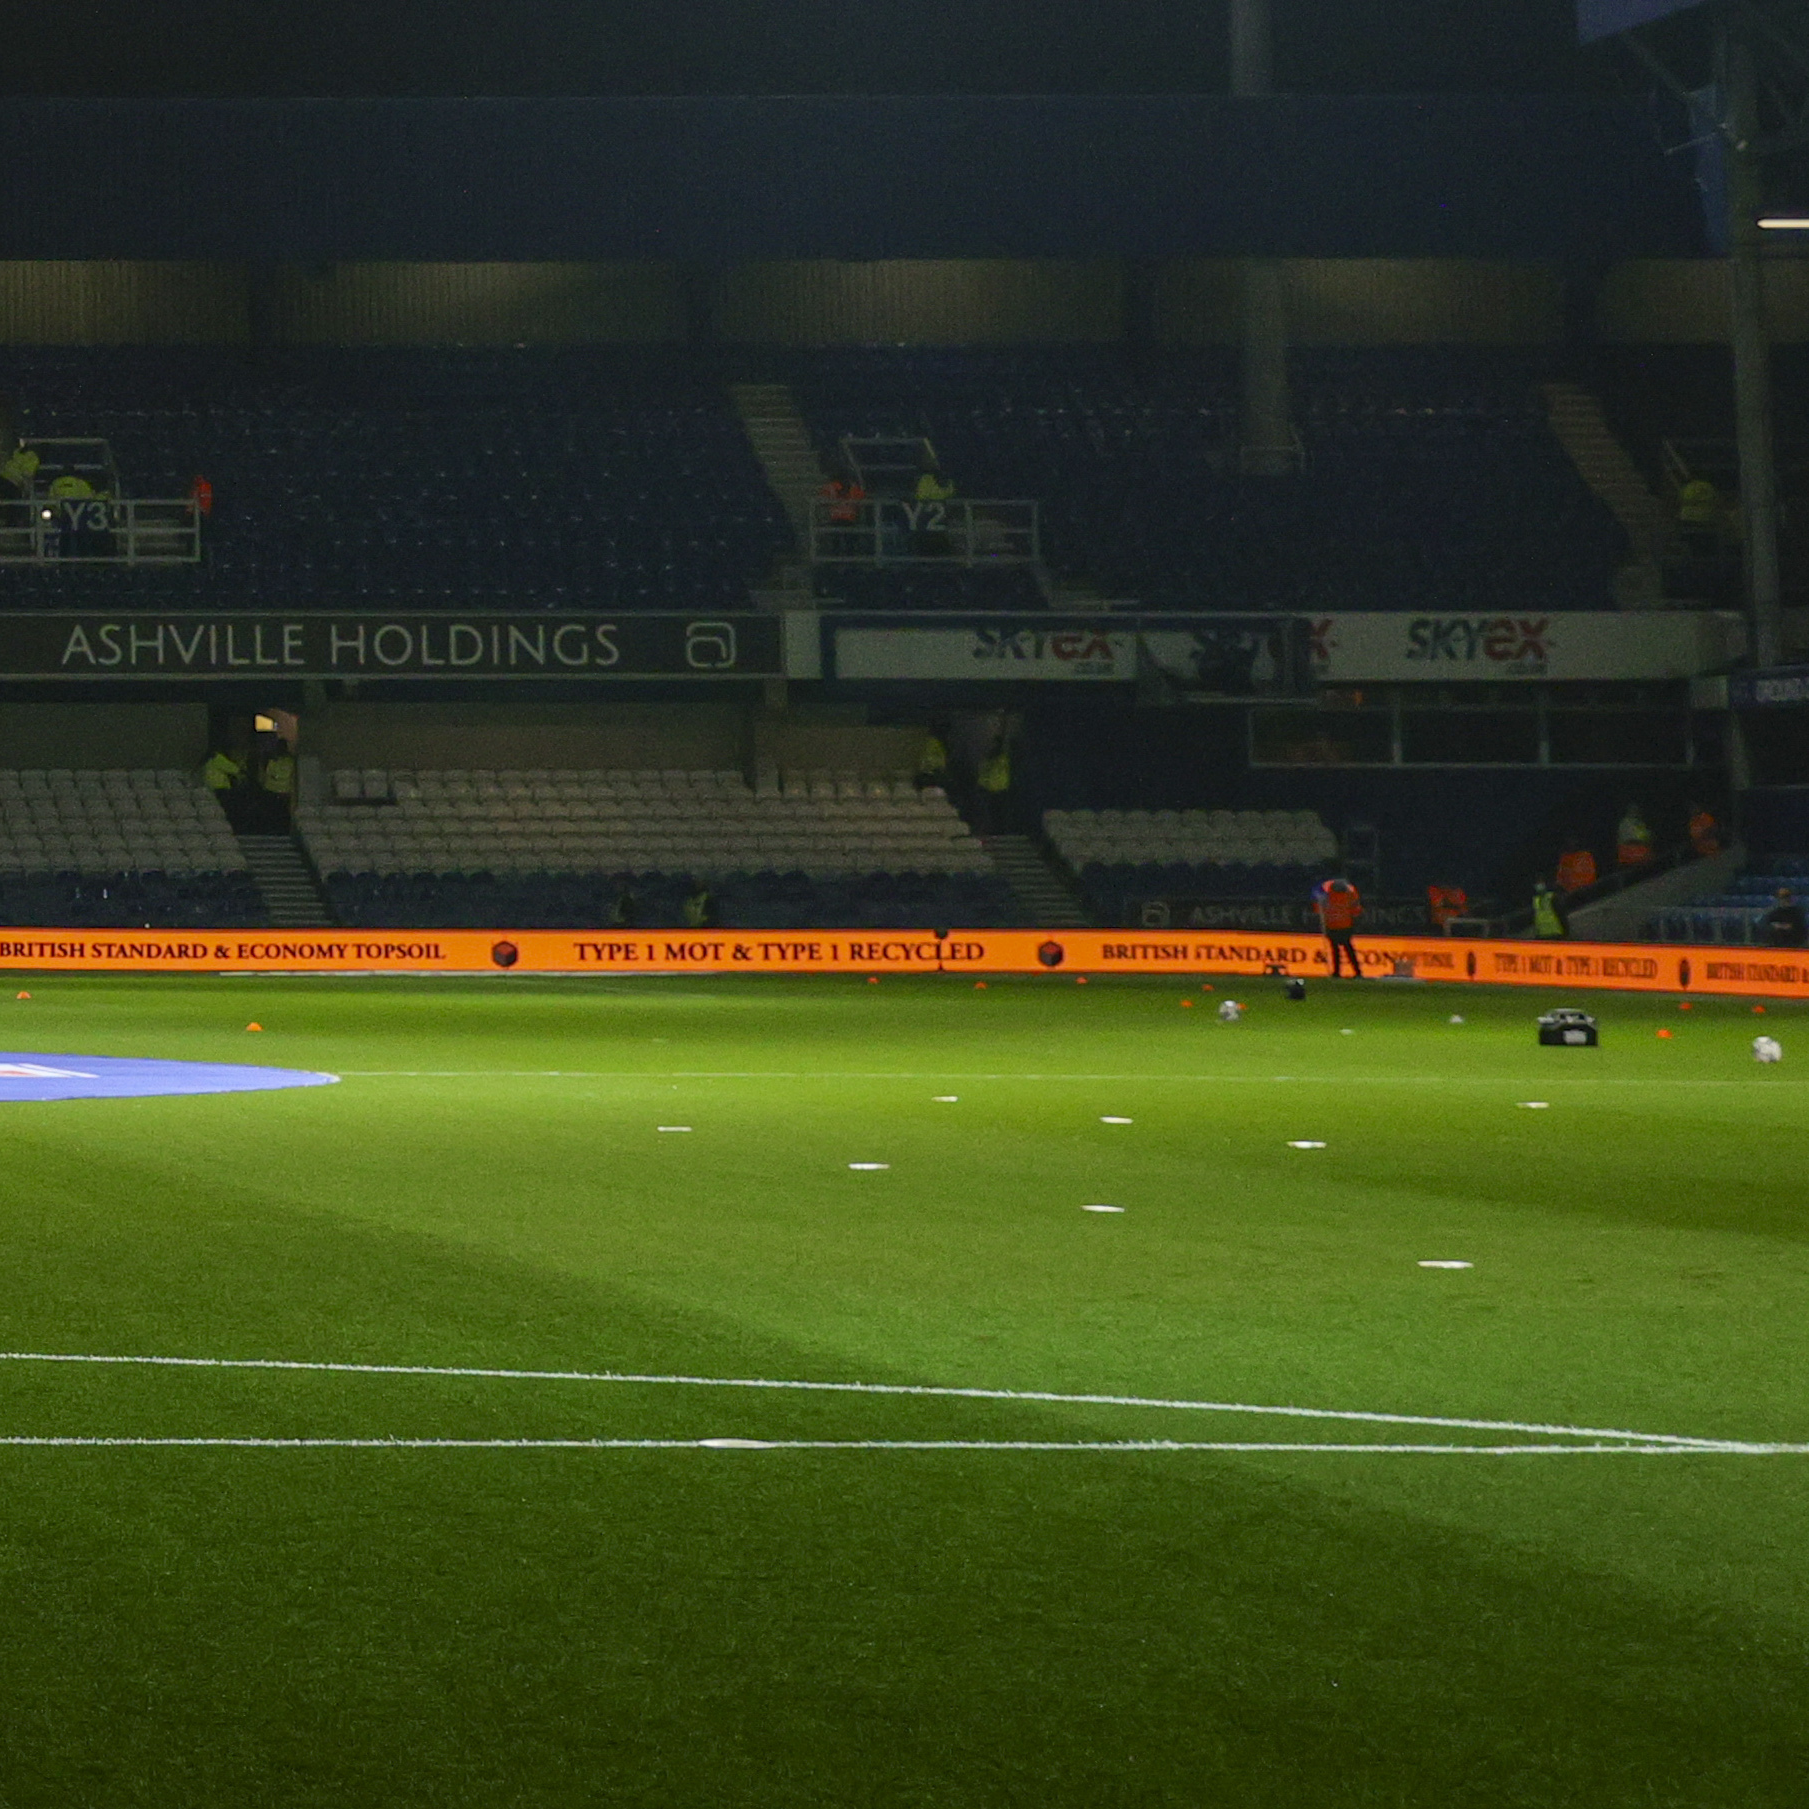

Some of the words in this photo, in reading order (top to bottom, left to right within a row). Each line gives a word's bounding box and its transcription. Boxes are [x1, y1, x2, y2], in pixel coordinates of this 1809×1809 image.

[63, 501, 108, 531] Y3
[902, 500, 946, 531] Y2
[62, 624, 305, 665] ASHVILLE
[331, 624, 620, 666] HOLDINGS
[0, 942, 85, 959] BRITISH
[91, 942, 208, 959] STANDARD
[214, 943, 229, 959] &
[237, 943, 348, 959] ECONOMY
[352, 943, 446, 959] TOPSOIL
[574, 943, 639, 961] TYPE
[647, 943, 655, 960] 1
[665, 943, 725, 960] MOT
[733, 943, 753, 960] &
[758, 943, 823, 960] TYPE
[831, 943, 840, 960] 1
[849, 942, 984, 960] RECYCLED
[1102, 944, 1188, 960] BRITISH
